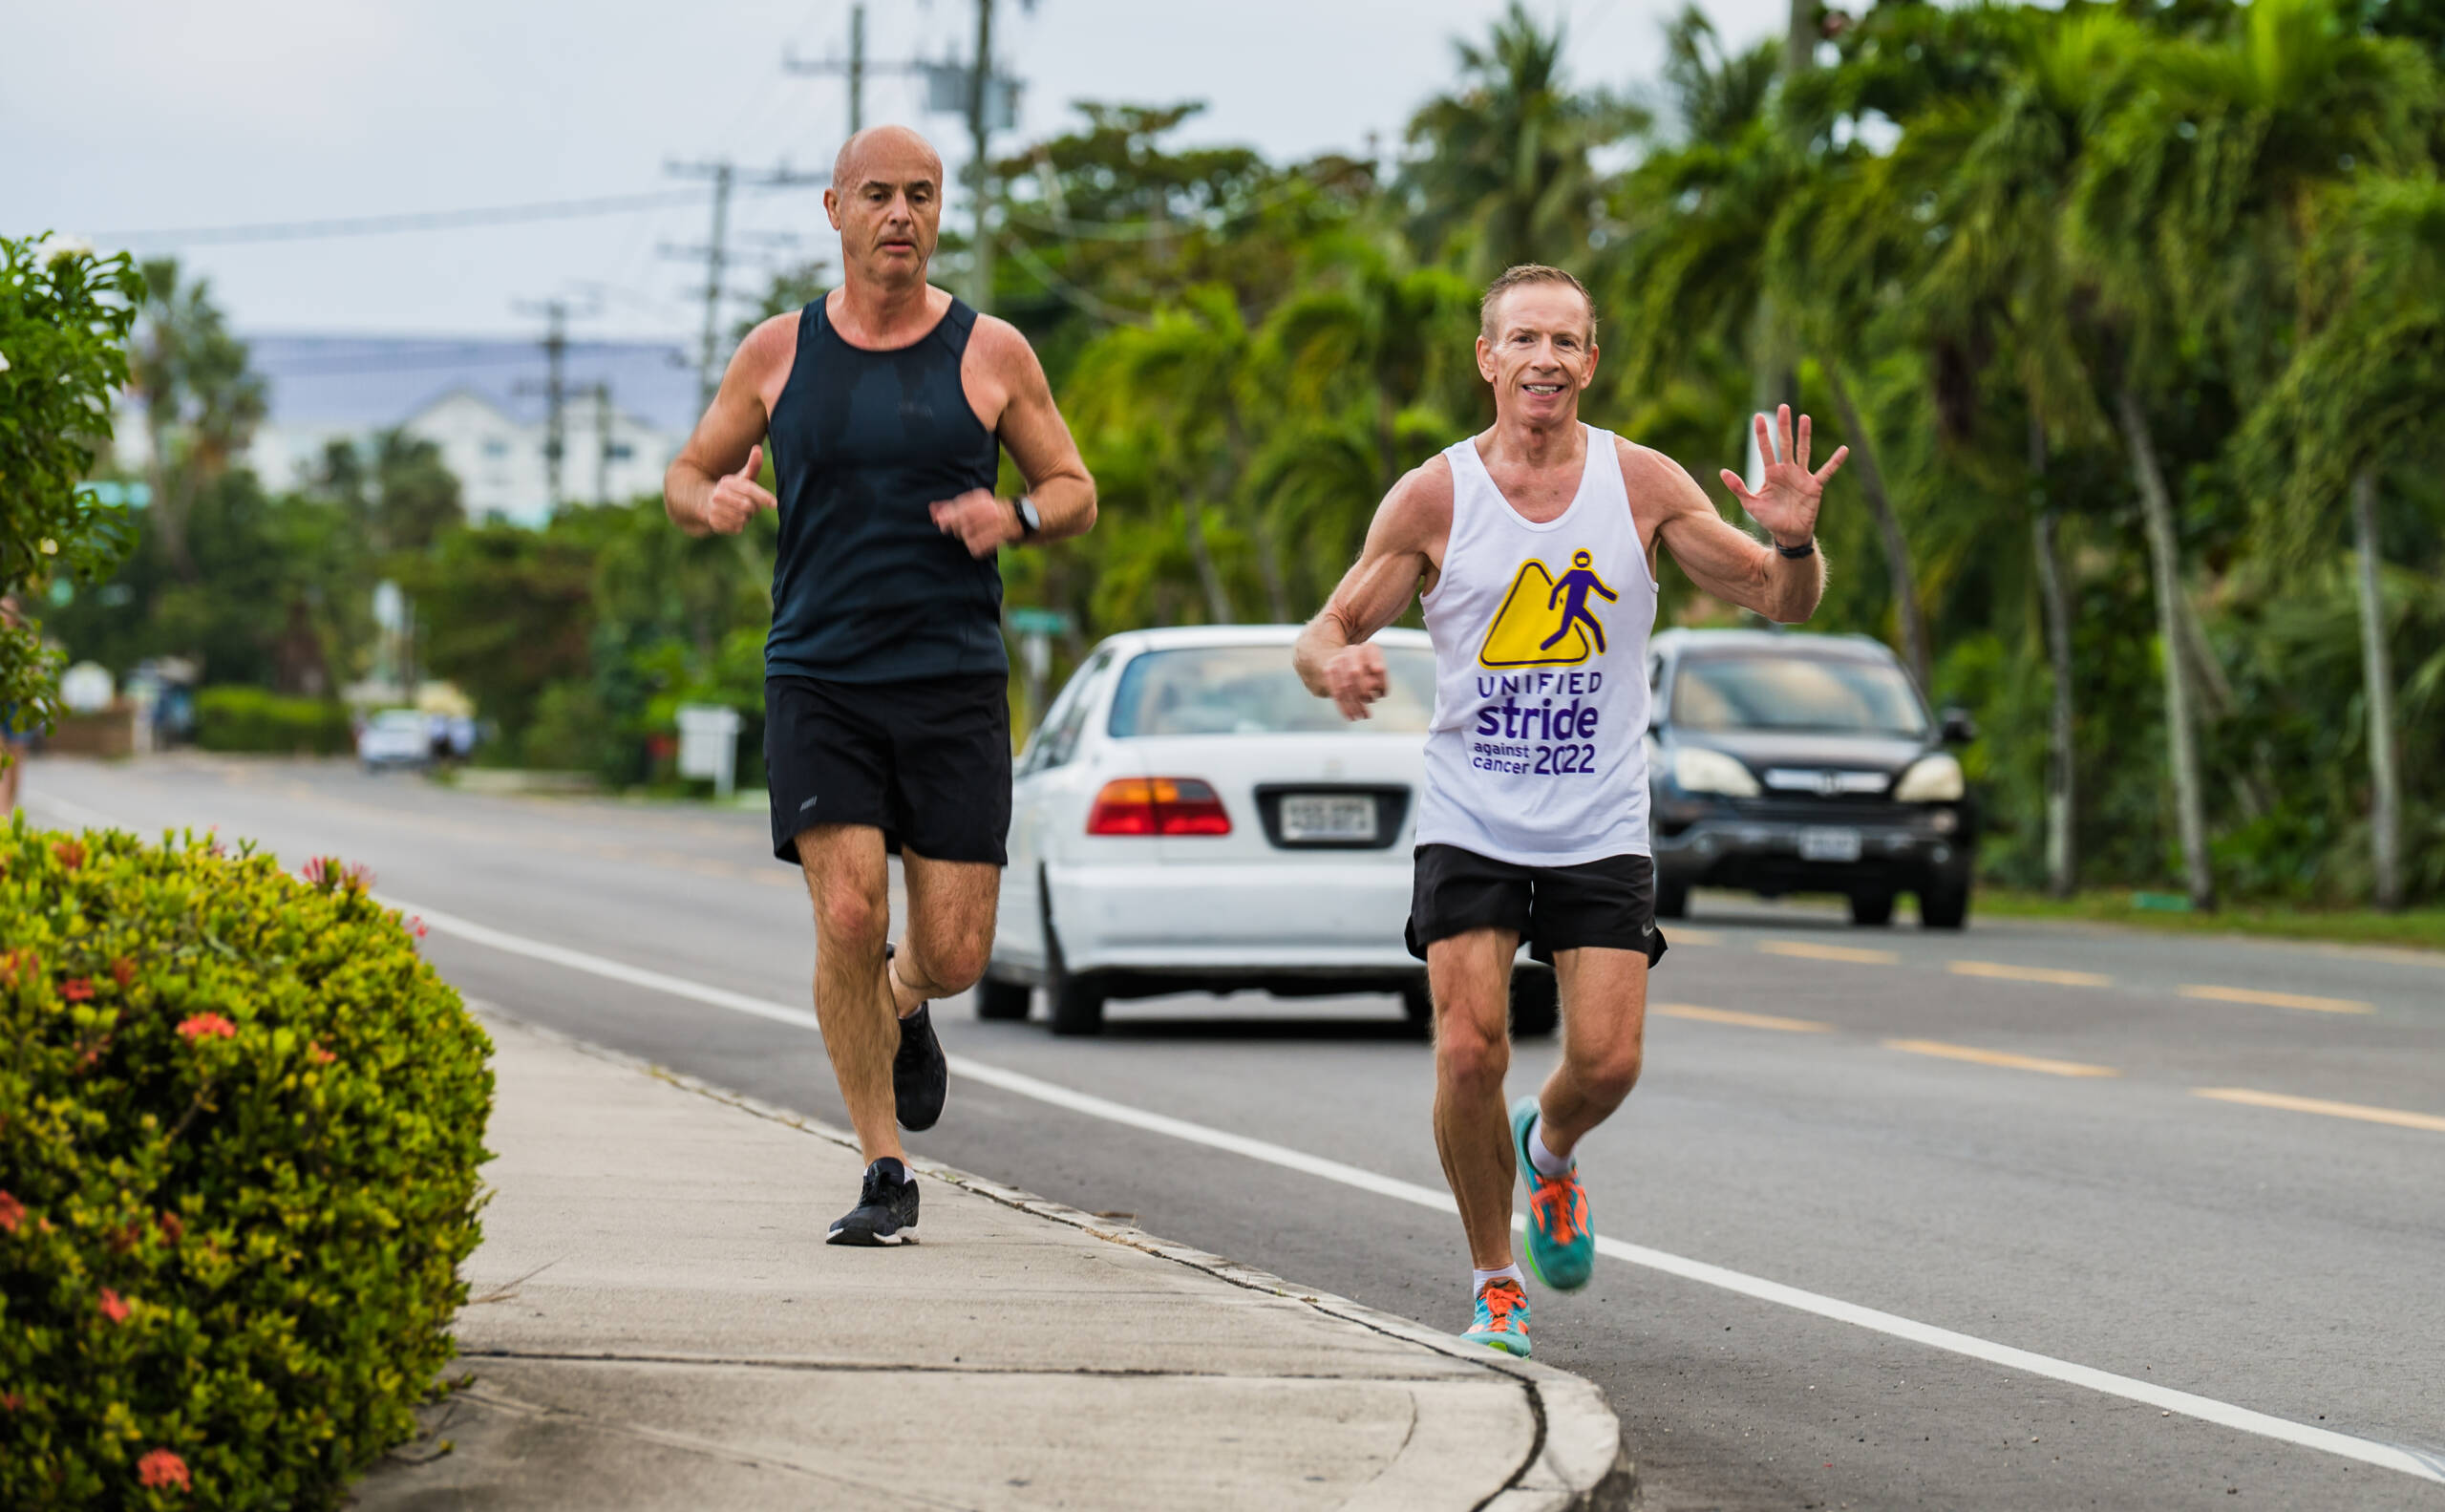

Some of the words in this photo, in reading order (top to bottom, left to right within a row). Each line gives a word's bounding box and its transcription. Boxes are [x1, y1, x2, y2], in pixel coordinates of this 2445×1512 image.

[1478, 671, 1603, 698] UNIFIED
[1477, 696, 1599, 740] stride
[1474, 742, 1530, 757] against
[1534, 743, 1596, 776] 2022
[1473, 756, 1530, 775] cancer
